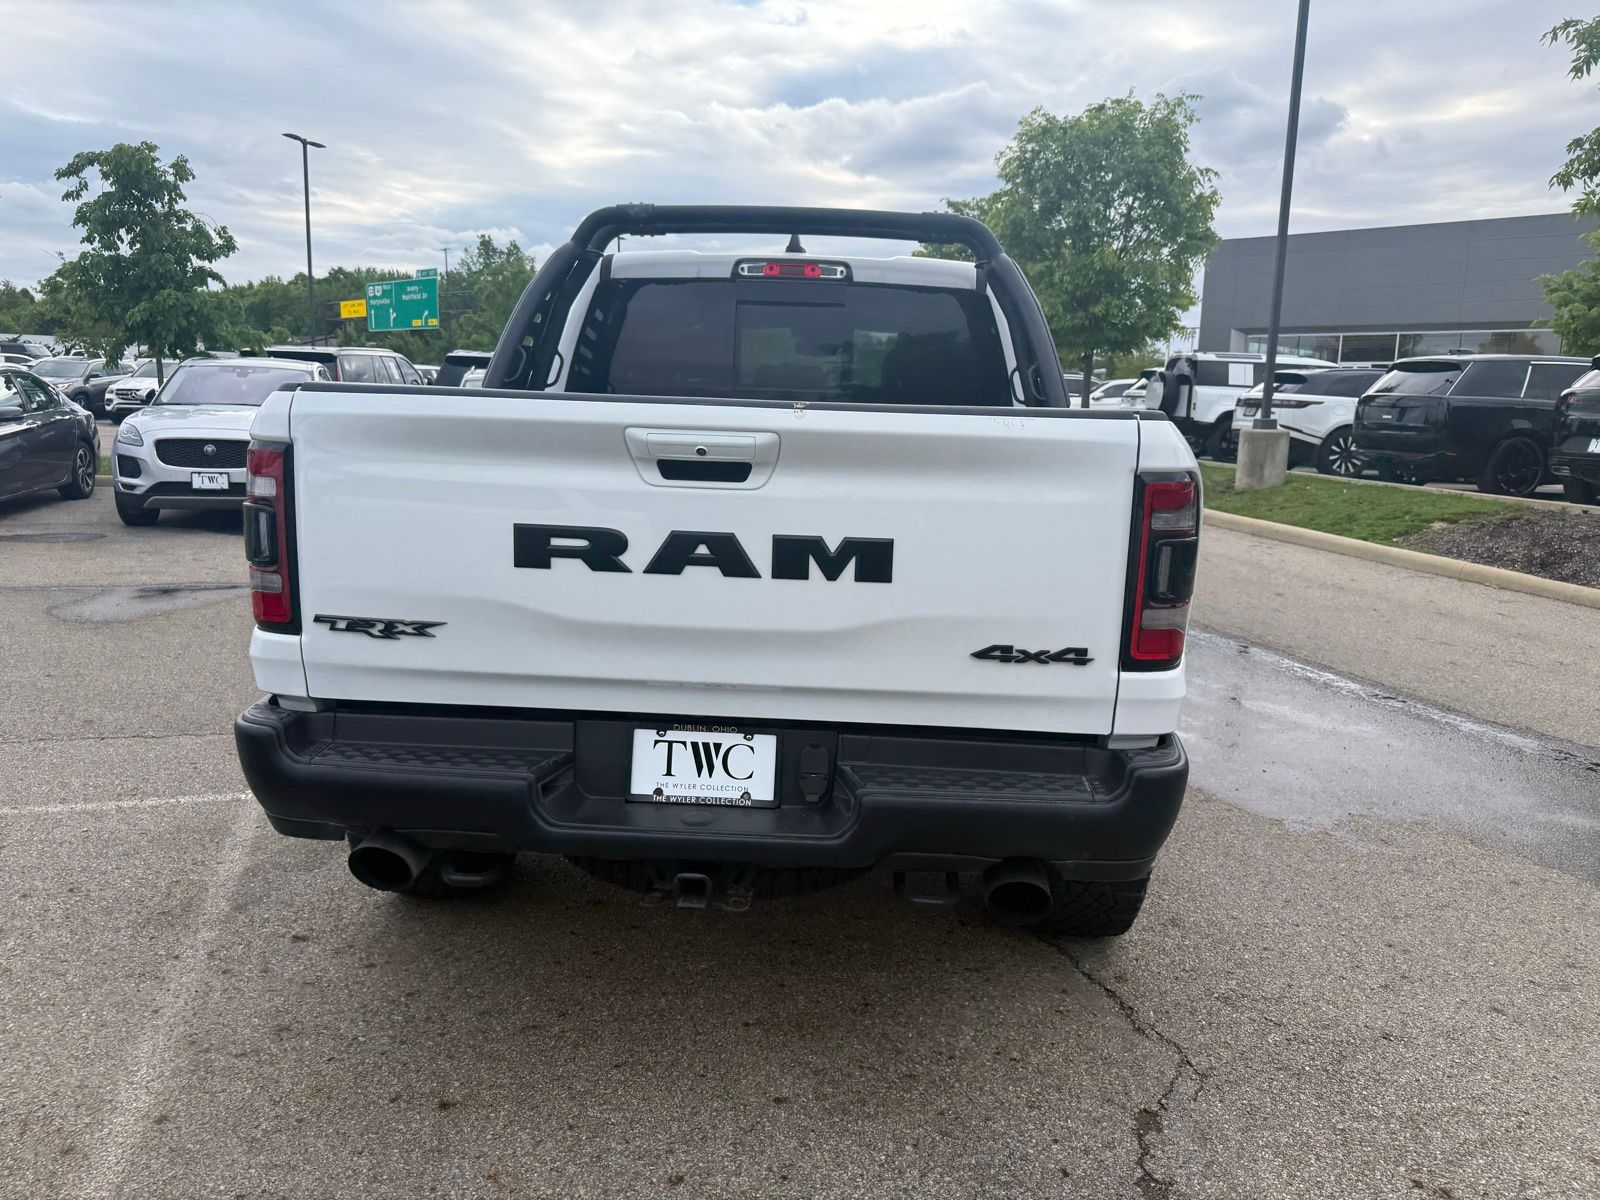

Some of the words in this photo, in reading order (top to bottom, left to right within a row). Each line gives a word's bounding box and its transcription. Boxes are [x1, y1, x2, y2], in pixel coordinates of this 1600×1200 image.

[198, 475, 224, 485] TWC
[513, 522, 894, 583] RAM
[313, 614, 448, 640] TRX
[969, 644, 1095, 666] 4x4
[711, 725, 738, 733] OHIO
[653, 739, 756, 780] TWC
[700, 784, 749, 792] COLLECTION
[669, 796, 696, 804] WYLER
[698, 797, 752, 806] COLLECTION
